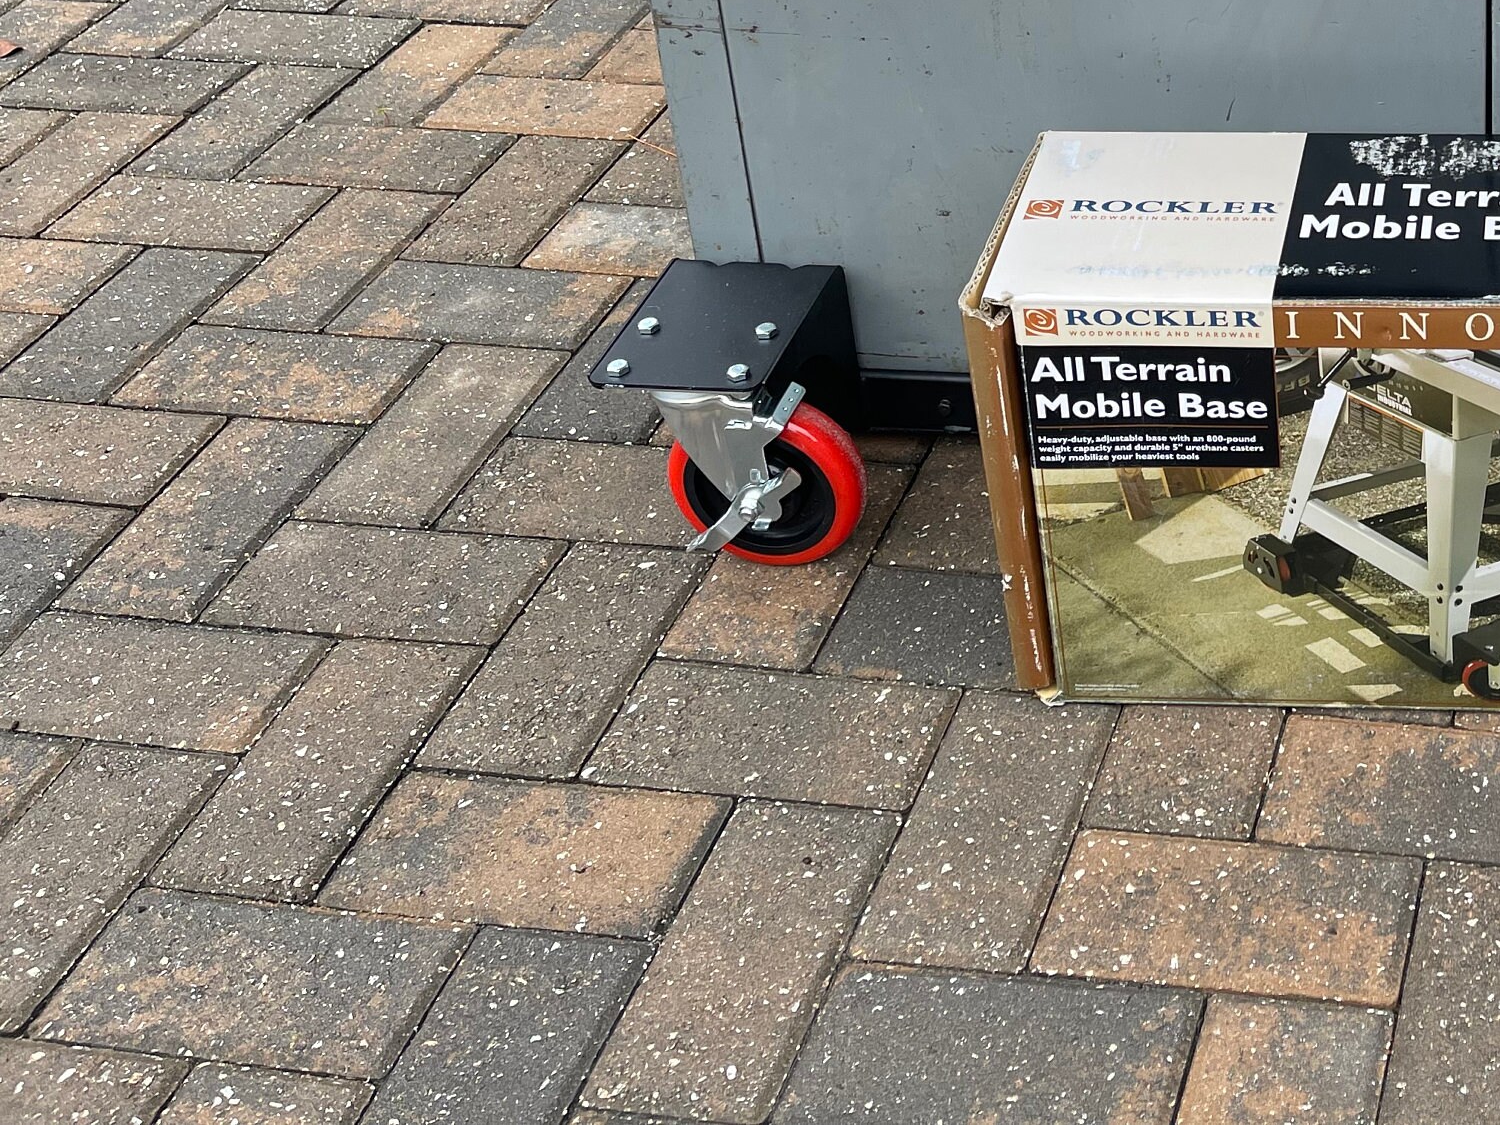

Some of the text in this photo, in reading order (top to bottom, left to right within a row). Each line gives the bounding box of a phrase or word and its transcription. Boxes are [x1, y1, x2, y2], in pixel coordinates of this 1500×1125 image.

[1324, 182, 1387, 207] All
[1069, 199, 1279, 214] ROCKLER
[1298, 213, 1461, 241] Mobile
[1064, 308, 1263, 327] ROCKLER
[1030, 355, 1232, 383] All Terrain
[1035, 392, 1268, 420] Mobile Base
[1037, 435, 1094, 445] Heavy-duty,
[1095, 434, 1144, 444] adjustable
[1145, 434, 1168, 442] base
[1169, 434, 1191, 442] with
[1206, 435, 1257, 444] 800-pound
[1039, 445, 1071, 454] weight
[1073, 444, 1112, 453] capacity
[1114, 443, 1132, 451] and
[1134, 443, 1171, 451] durable
[1185, 444, 1229, 452] urethane
[1040, 452, 1200, 463] easily mobilize your heaviest tools
